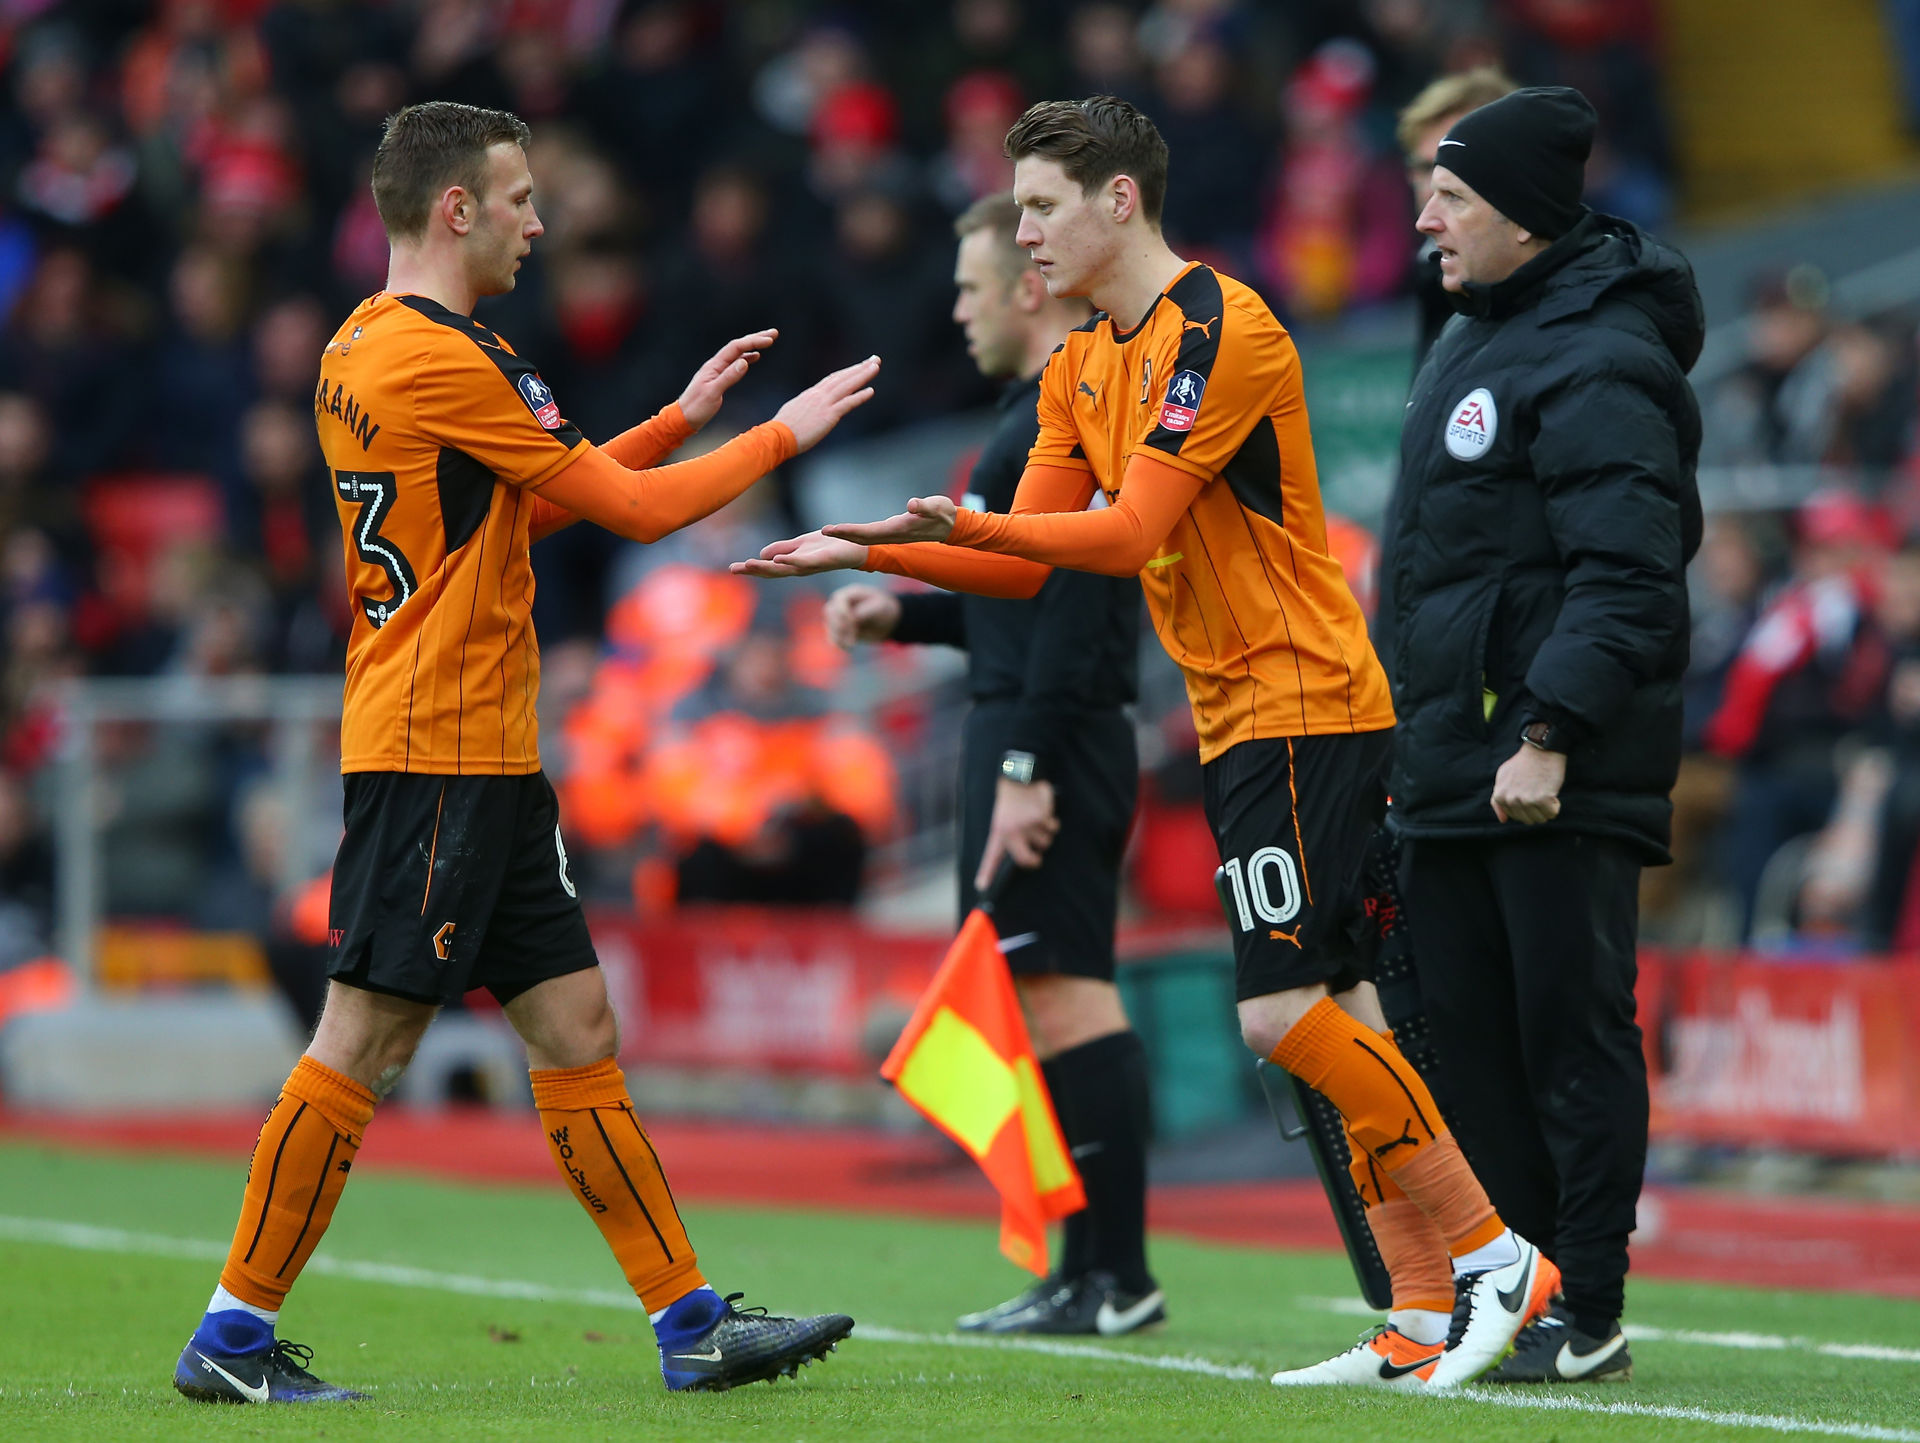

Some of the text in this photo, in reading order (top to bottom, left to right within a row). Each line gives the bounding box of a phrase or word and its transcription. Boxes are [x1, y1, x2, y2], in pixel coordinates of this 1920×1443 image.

[316, 378, 381, 452] MANN
[1448, 424, 1487, 445] SPORTS
[1455, 401, 1485, 432] EA
[1224, 846, 1302, 932] 10
[550, 1125, 608, 1213] WOLVES
